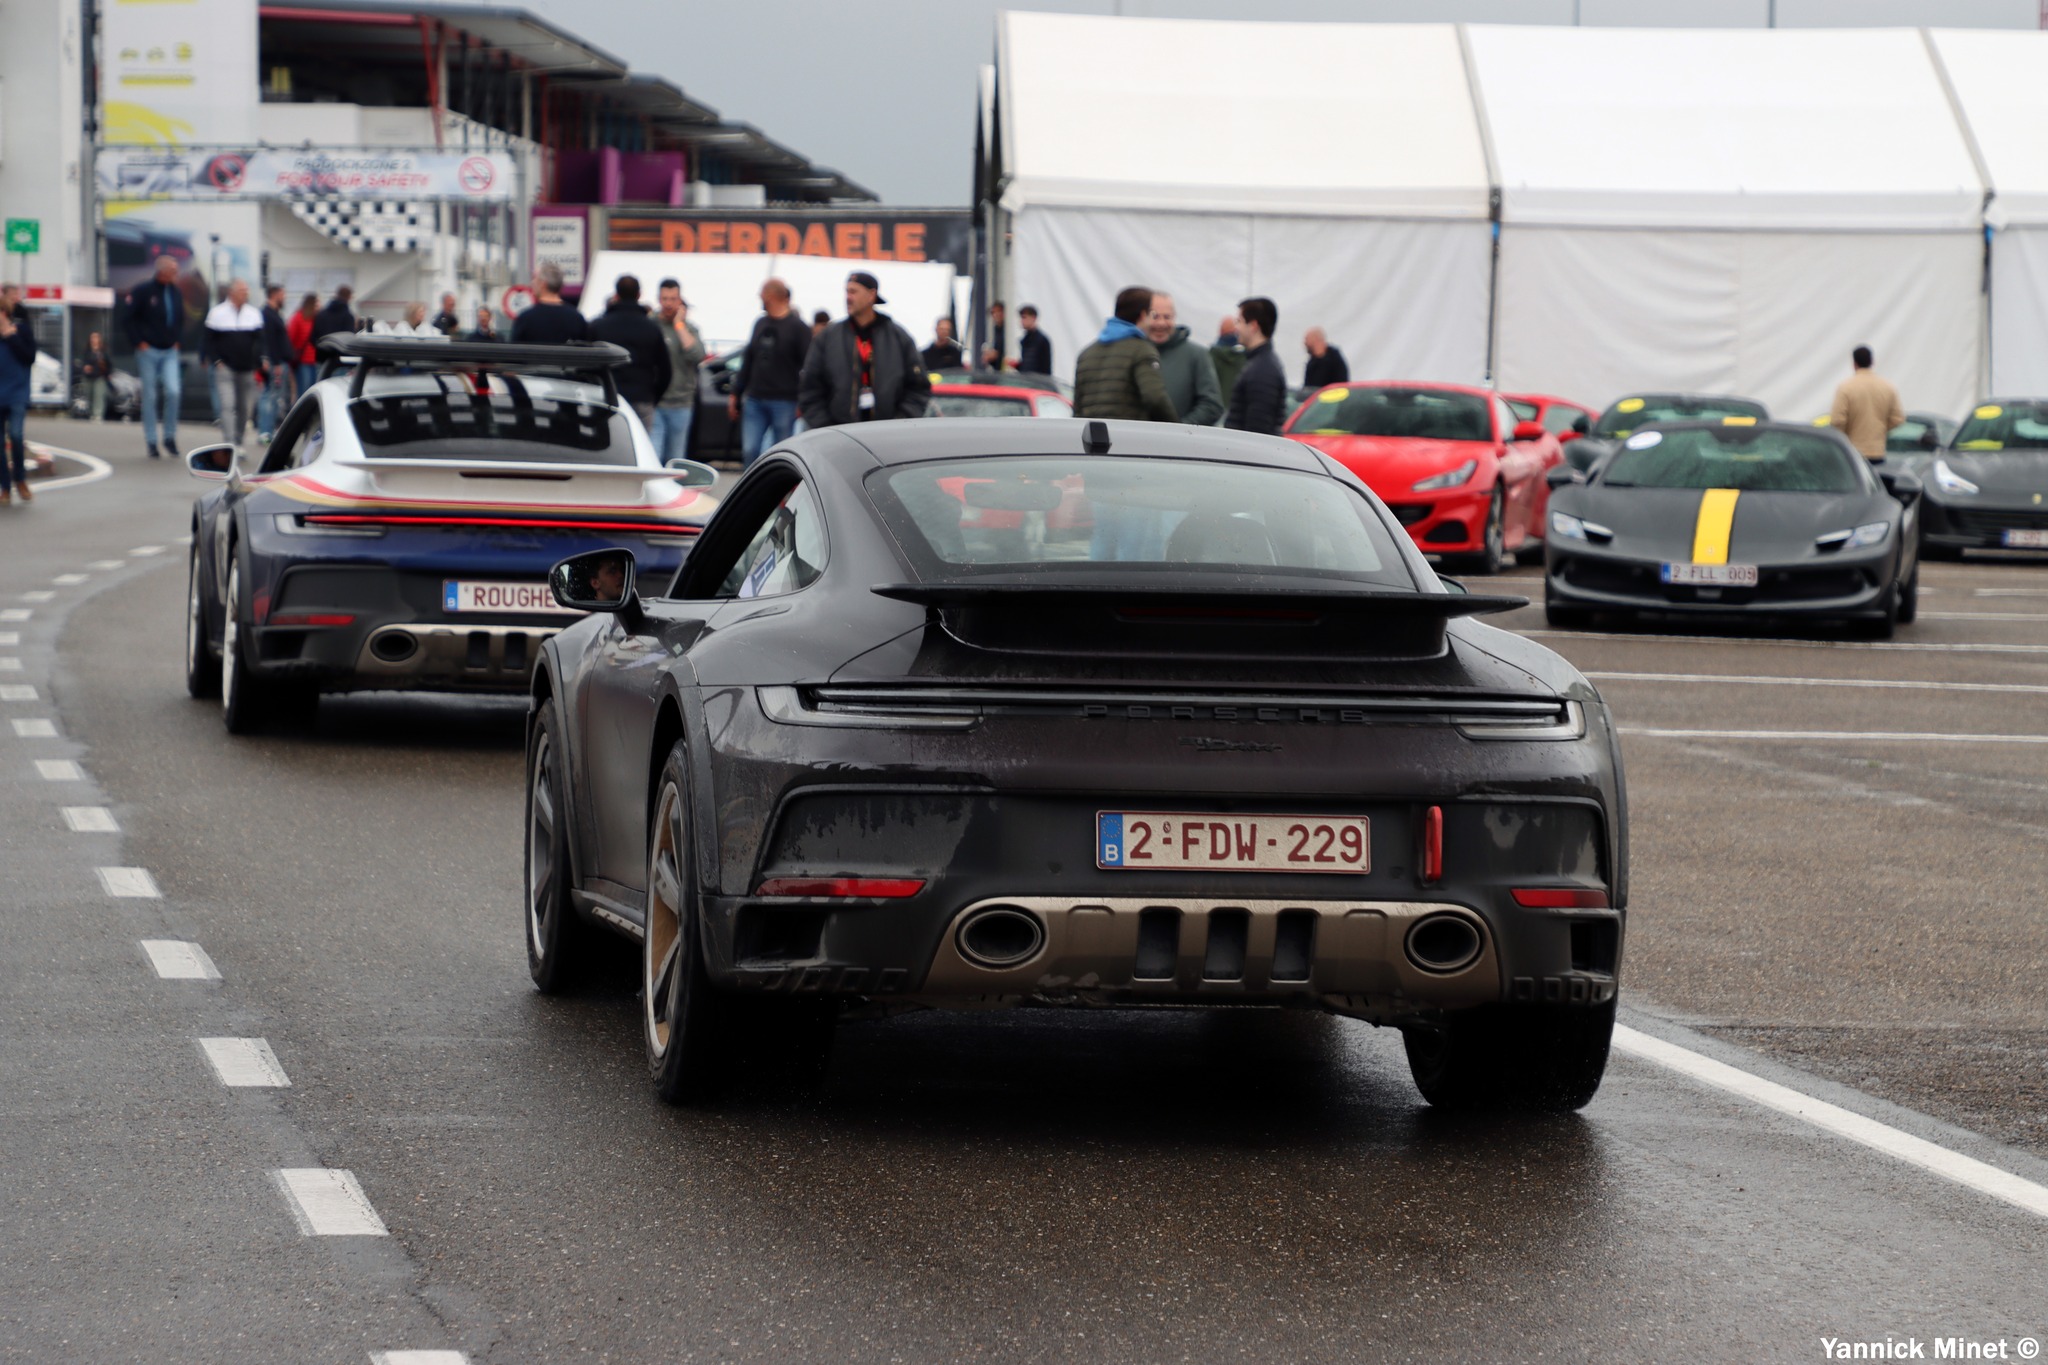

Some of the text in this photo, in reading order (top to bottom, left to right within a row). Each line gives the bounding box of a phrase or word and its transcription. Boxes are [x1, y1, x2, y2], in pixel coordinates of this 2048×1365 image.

[277, 172, 431, 187] FOR YOUR SAFETY
[660, 221, 928, 263] DERDAELE
[473, 586, 556, 608] ROUGHE
[1083, 704, 1365, 723] PORSCHE
[1104, 820, 1363, 864] B 2-FDW-229
